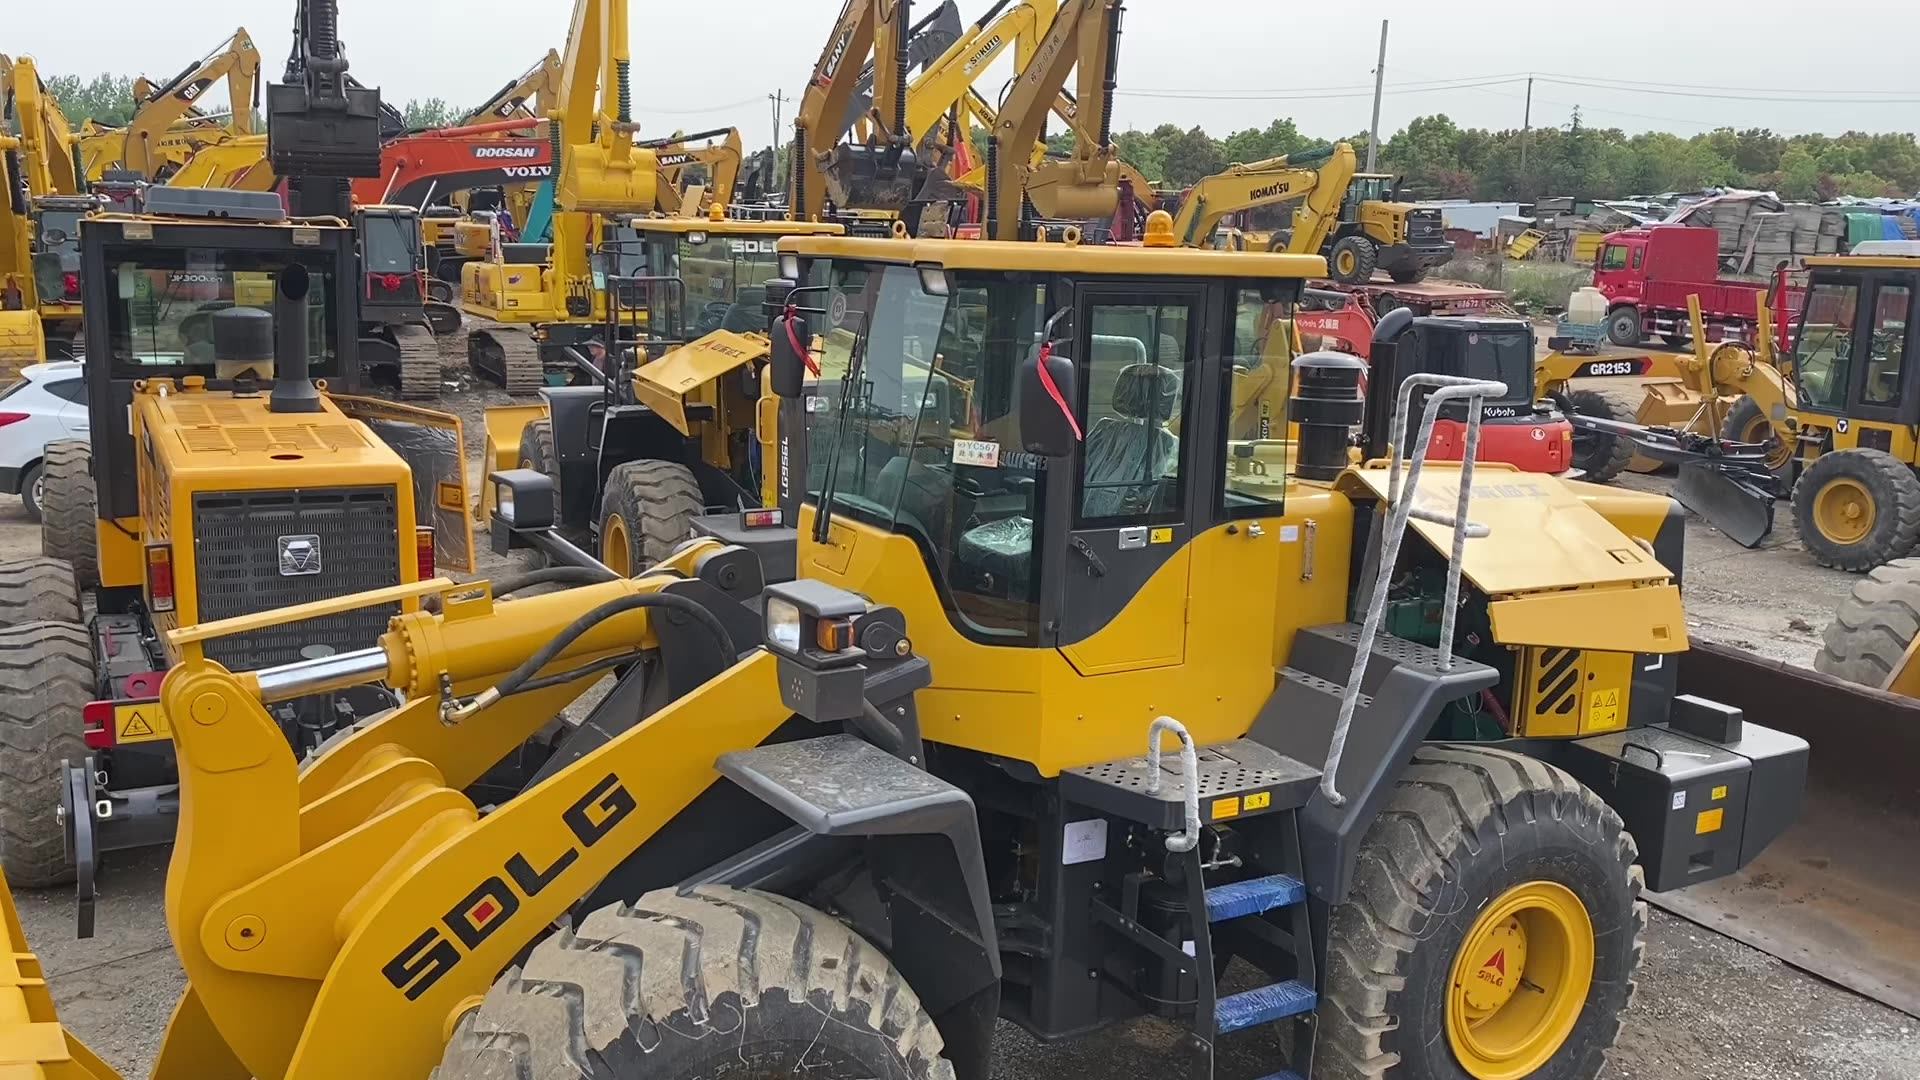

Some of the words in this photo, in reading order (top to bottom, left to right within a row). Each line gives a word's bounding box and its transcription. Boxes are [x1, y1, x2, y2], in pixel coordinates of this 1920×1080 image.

[826, 33, 846, 77] SANY
[969, 34, 1001, 65] SOKUTO
[183, 82, 201, 100] CAT
[500, 101, 516, 117] CAT
[475, 147, 536, 158] DOOSAN
[660, 154, 687, 165] SANY
[1249, 182, 1290, 201] KOMATSU
[731, 240, 778, 253] SDL
[1590, 361, 1632, 376] GR2153
[1483, 406, 1516, 418] Kubota
[781, 436, 789, 498] LG956L
[381, 772, 637, 1002] SDLG
[1476, 969, 1504, 986] SDLG
